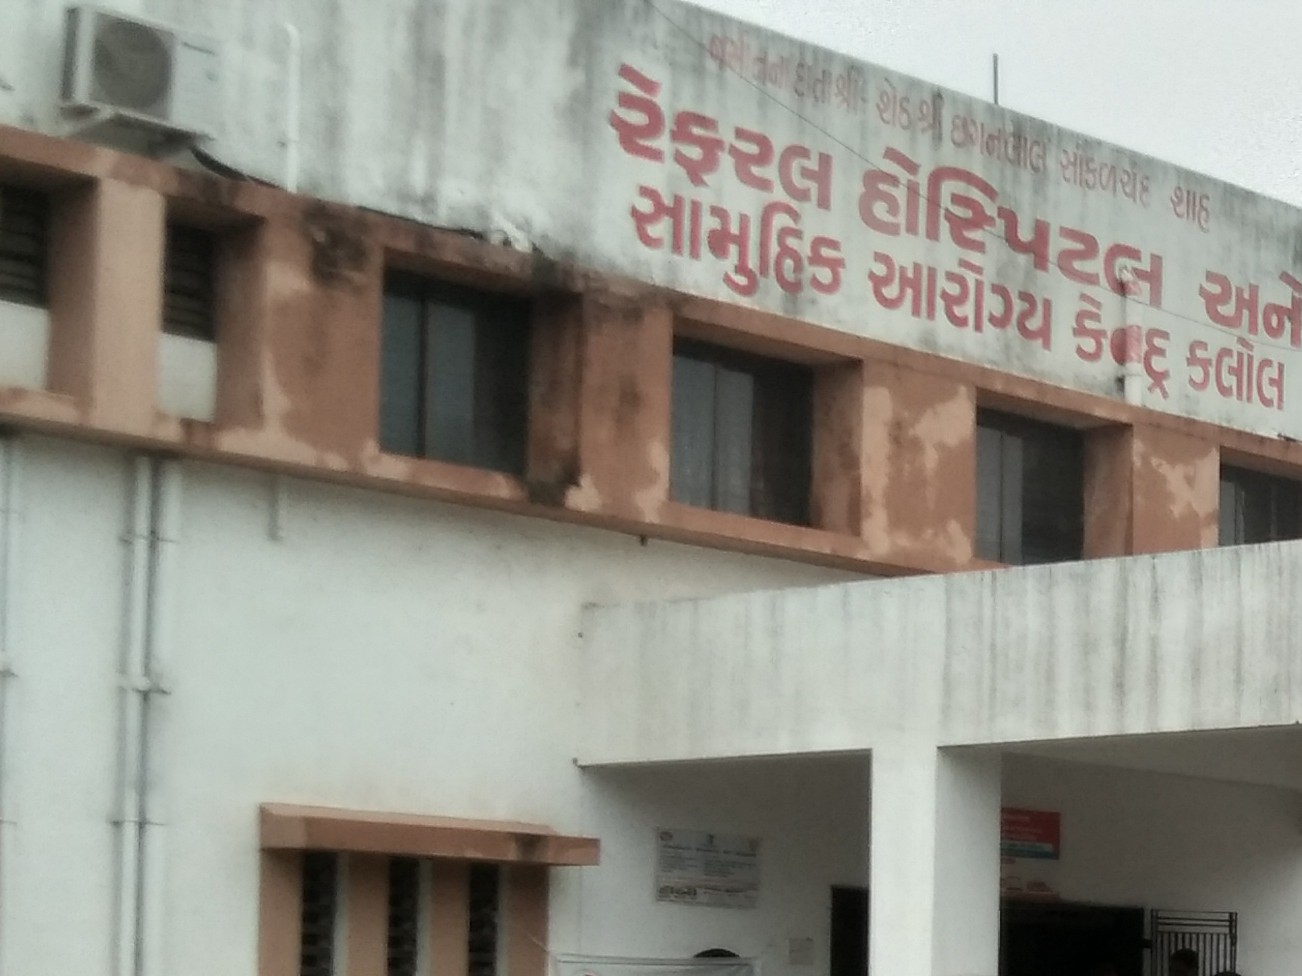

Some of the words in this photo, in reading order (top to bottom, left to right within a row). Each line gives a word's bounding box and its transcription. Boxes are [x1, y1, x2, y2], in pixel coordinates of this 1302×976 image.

[609, 63, 833, 211] રેફરલ
[858, 146, 1164, 310] હોસ્પિટલ
[630, 184, 847, 298] સામુહિક
[867, 250, 1053, 352] આરોગ્ય
[1186, 336, 1285, 411] કલોલ
